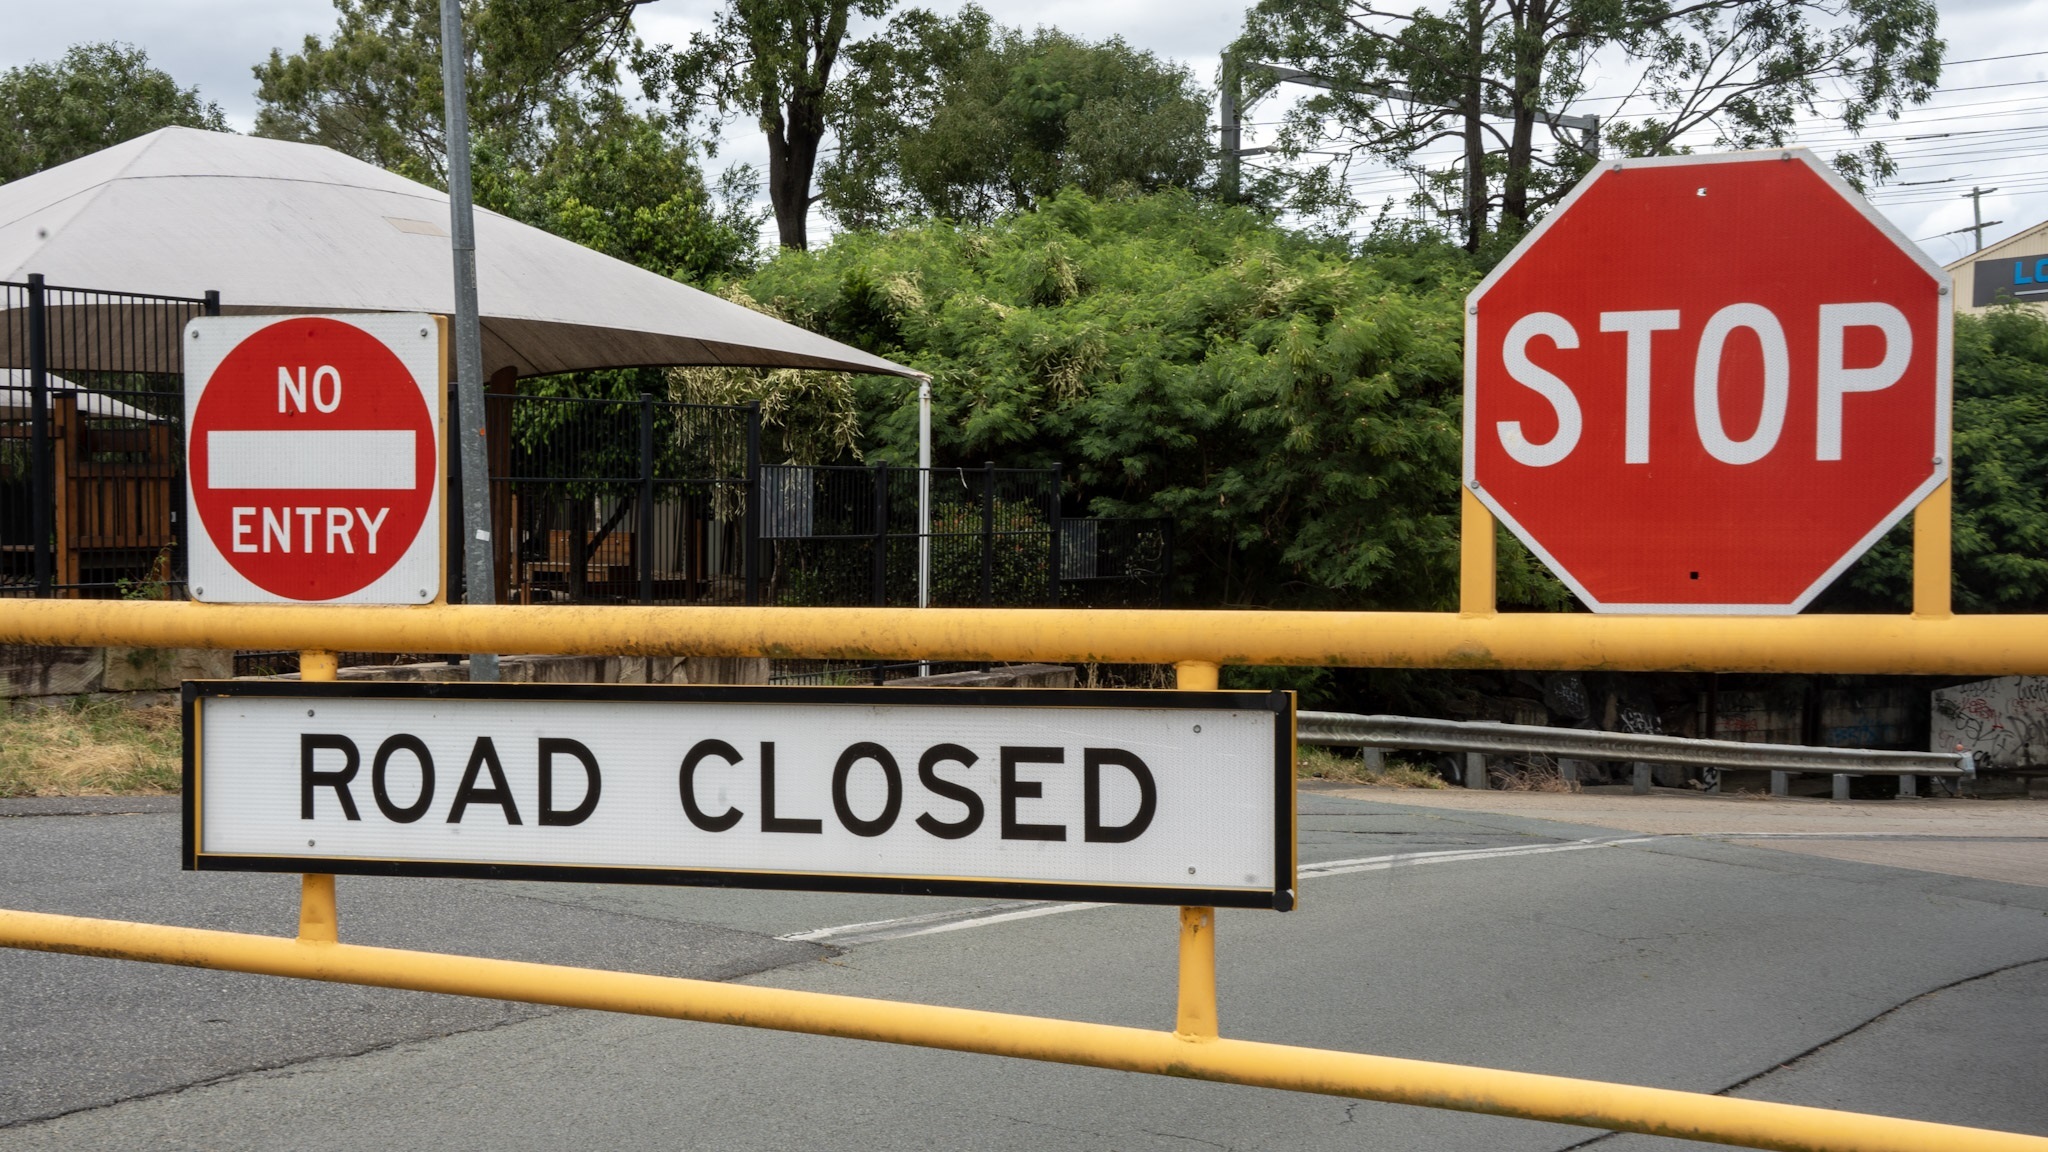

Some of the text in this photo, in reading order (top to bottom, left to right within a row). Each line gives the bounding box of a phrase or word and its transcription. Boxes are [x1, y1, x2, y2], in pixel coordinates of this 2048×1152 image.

[278, 364, 342, 413] NO
[1496, 301, 1913, 468] STOP
[232, 506, 390, 554] ENTRY
[300, 733, 1158, 844] ROAD CLOSED
